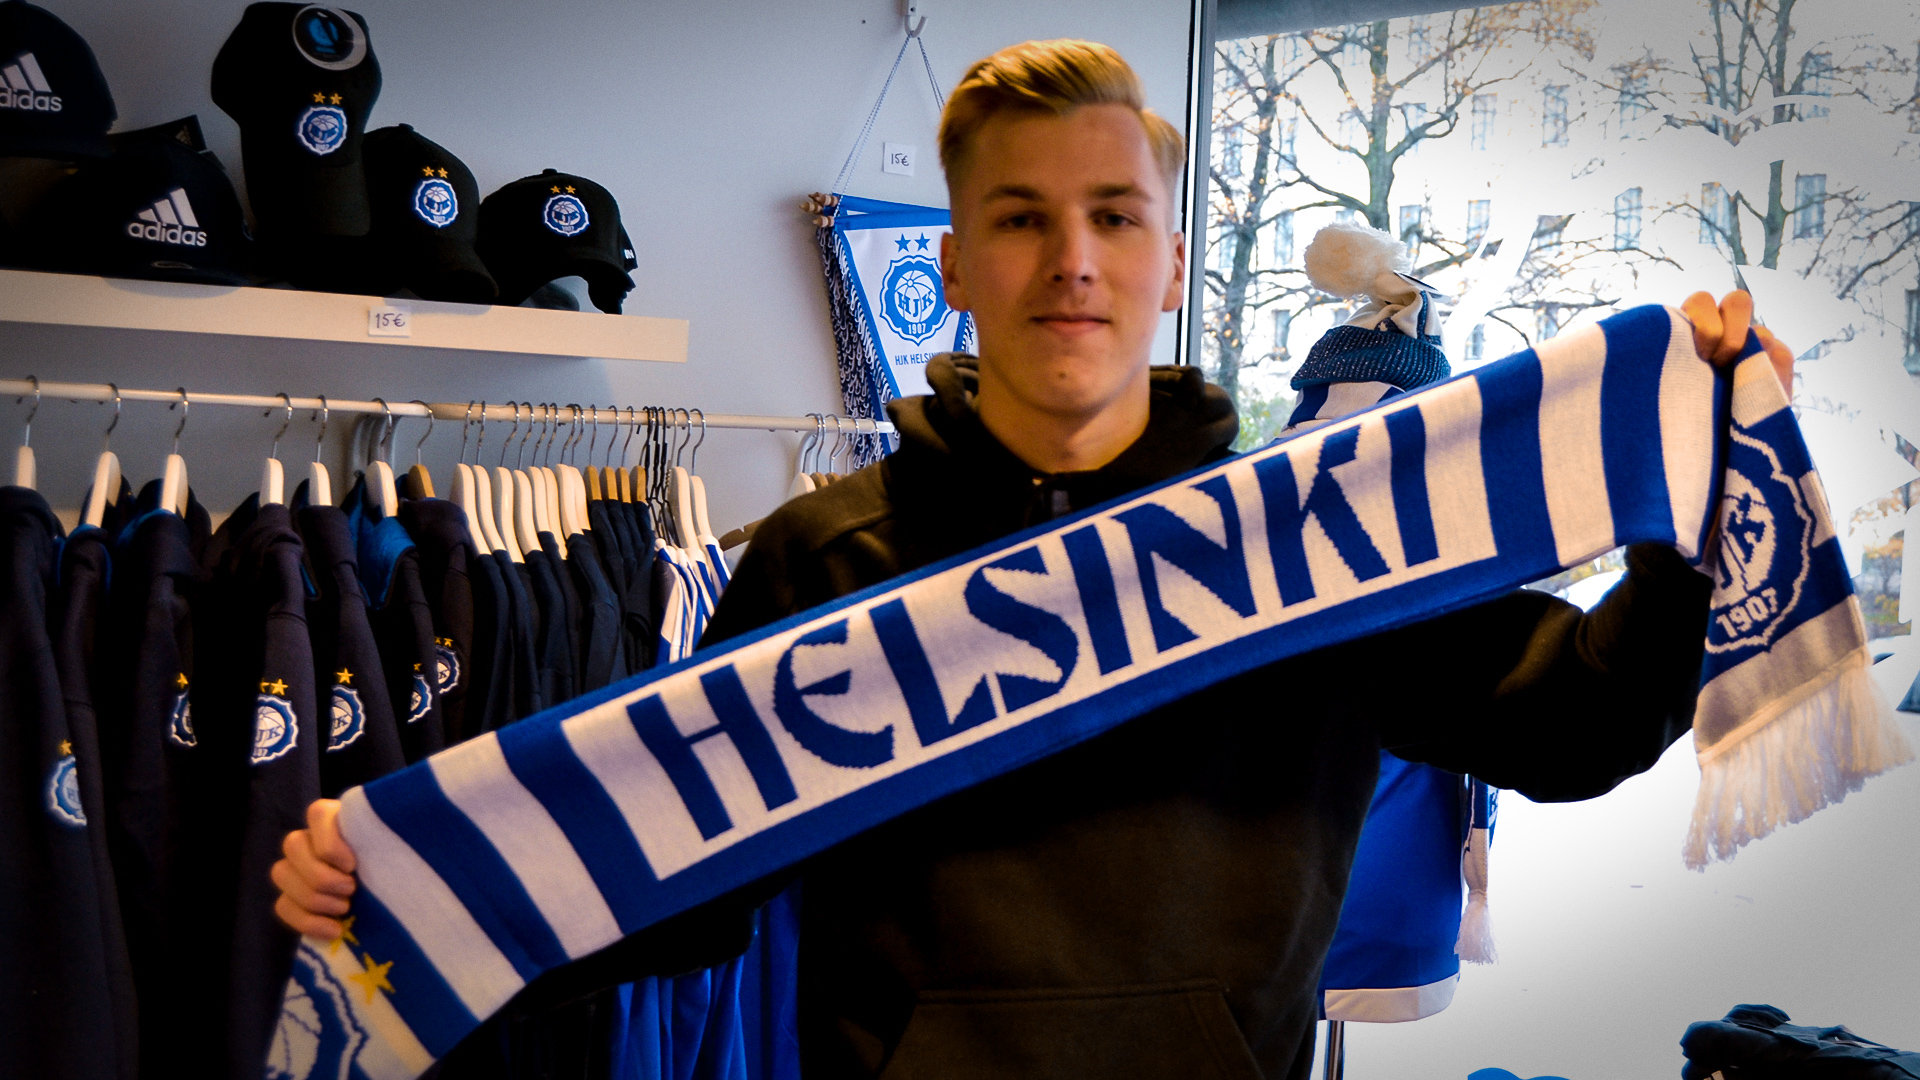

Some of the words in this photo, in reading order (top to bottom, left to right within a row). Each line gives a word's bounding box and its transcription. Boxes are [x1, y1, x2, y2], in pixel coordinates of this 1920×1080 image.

[0, 88, 62, 111] didas
[890, 153, 910, 167] 15€
[128, 221, 207, 247] adidas
[896, 290, 934, 318] HJK
[375, 313, 406, 328] 15€
[907, 322, 926, 335] 1907
[895, 354, 909, 366] HJK
[910, 351, 944, 365] HELSI
[625, 403, 1441, 843] HELSINKI
[1715, 586, 1778, 639] 1907
